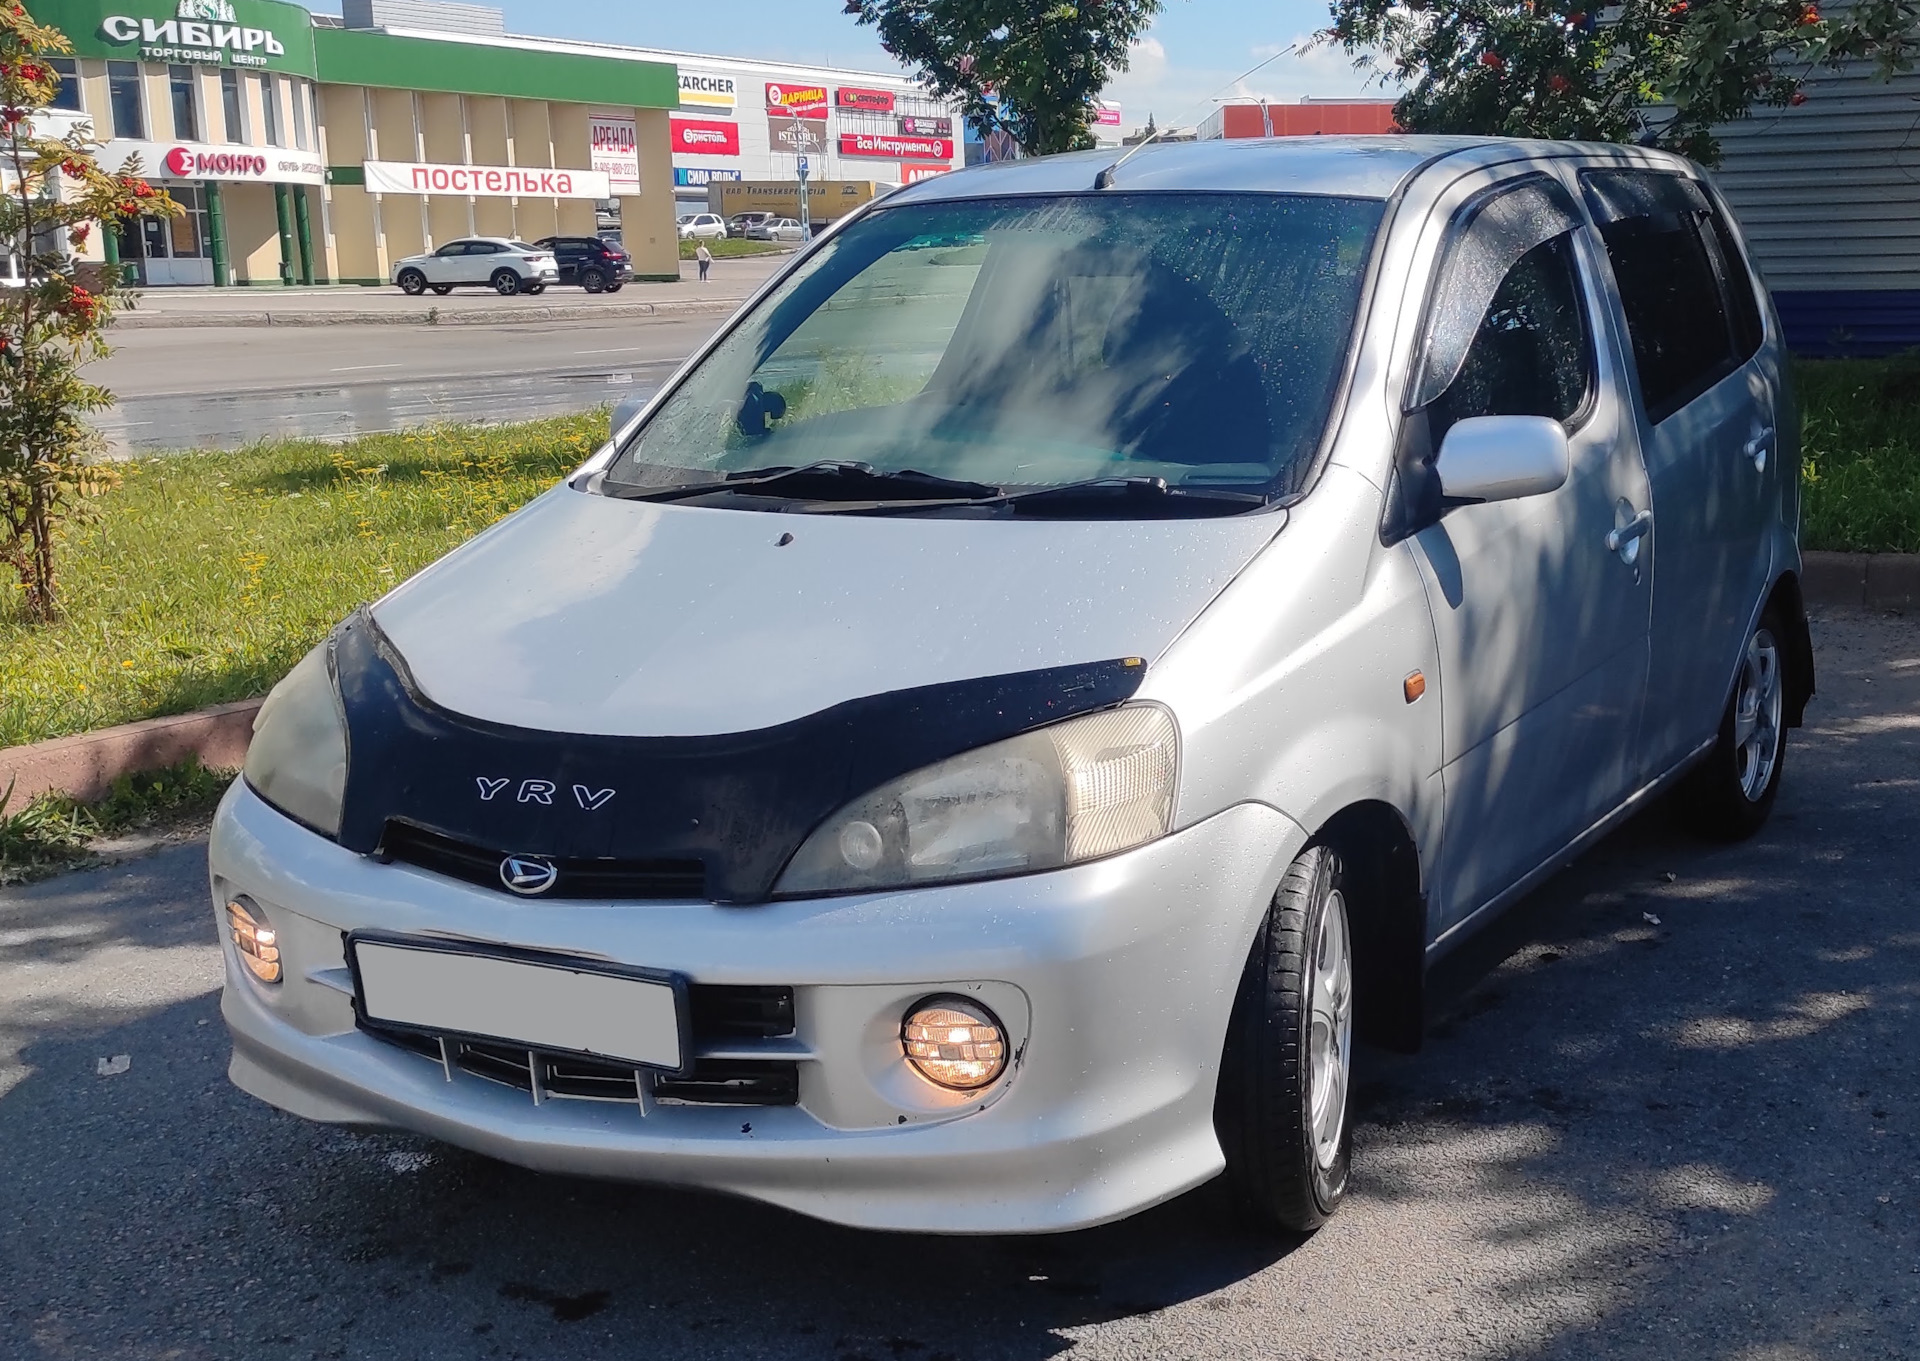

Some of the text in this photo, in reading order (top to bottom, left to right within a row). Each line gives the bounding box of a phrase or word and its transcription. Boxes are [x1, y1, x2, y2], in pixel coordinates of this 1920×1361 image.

[103, 16, 285, 55] СИБИРЬ
[141, 47, 267, 66] ТОРГОВЫЙ ЦЕНТР
[781, 89, 824, 105] ДАРНИЦА
[593, 125, 636, 153] АРЕНДА
[197, 153, 267, 174] МОНРО
[687, 170, 709, 185] СИЛА
[476, 777, 616, 810] YRV
